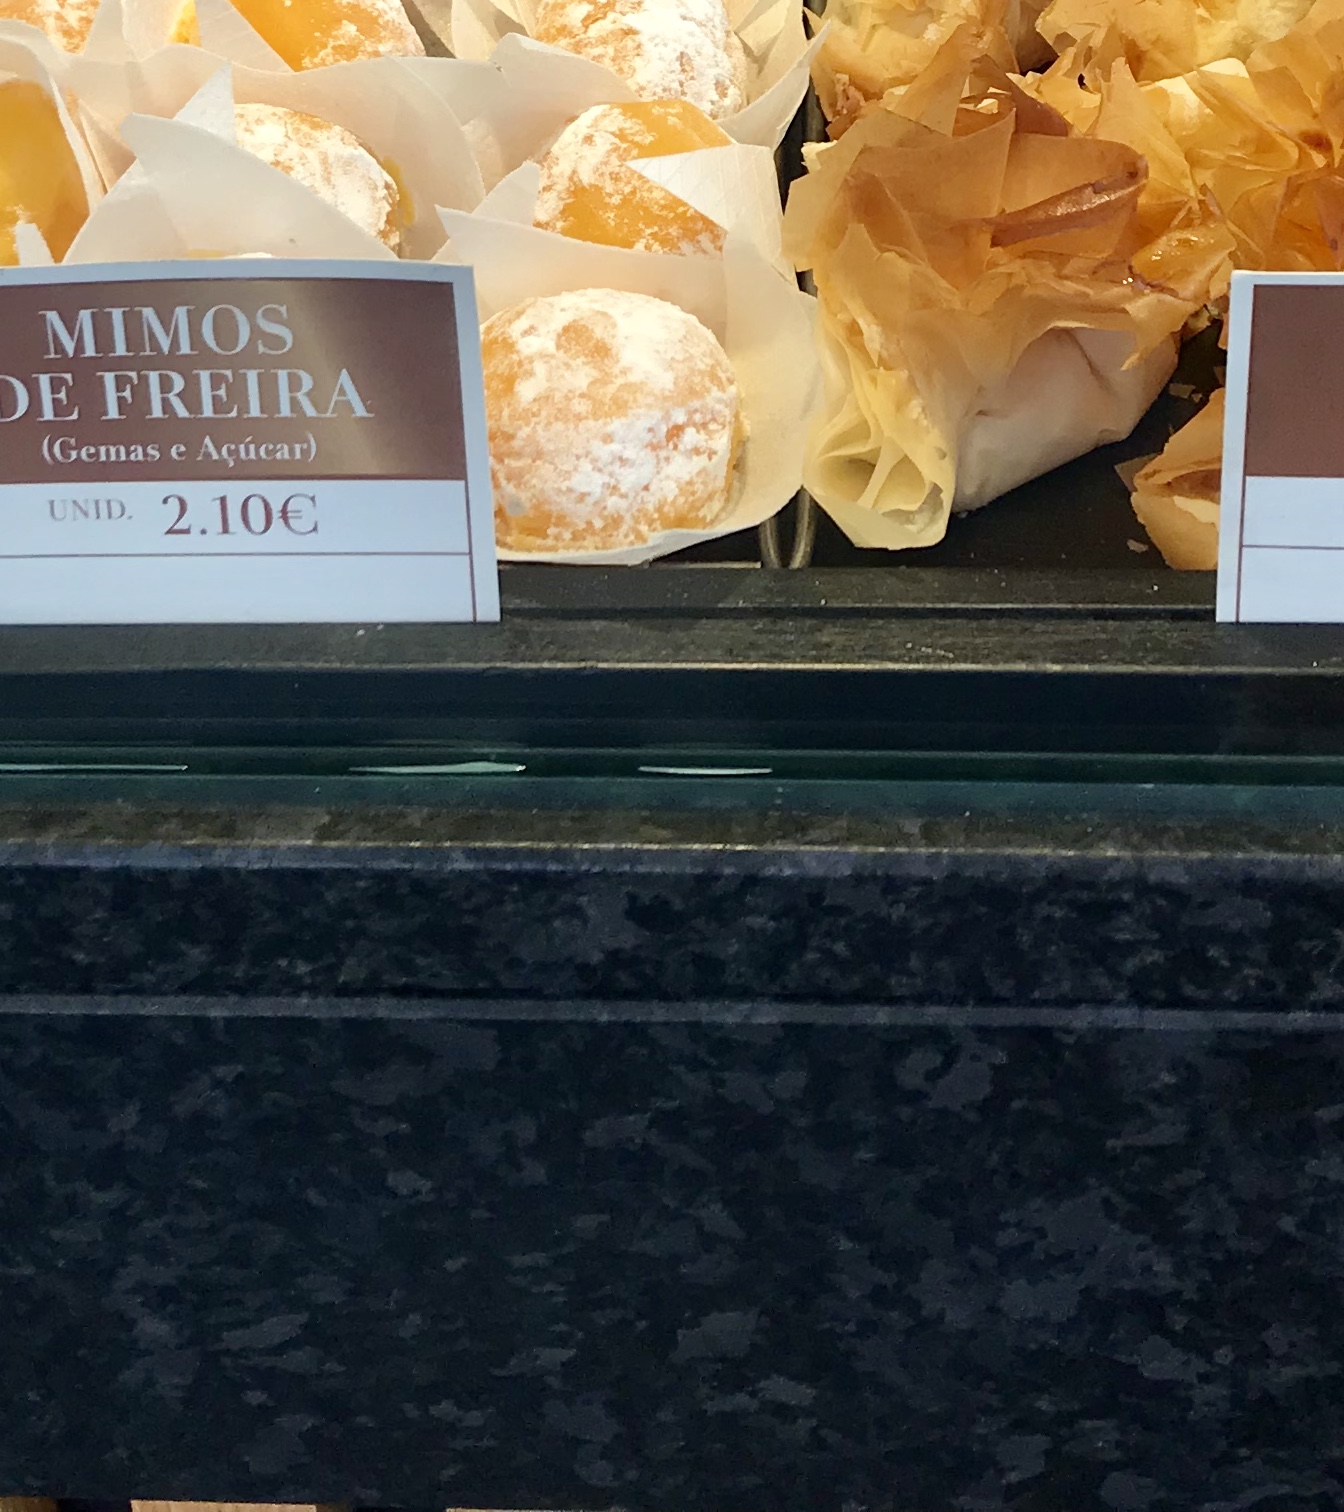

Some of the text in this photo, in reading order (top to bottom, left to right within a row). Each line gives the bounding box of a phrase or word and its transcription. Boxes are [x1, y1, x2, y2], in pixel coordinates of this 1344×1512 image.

[38, 303, 295, 359] MIMOS
[96, 367, 375, 421] FREIRA
[41, 434, 318, 469] (Gemas e Açúcar)
[47, 493, 320, 537] UNID. 2.10€
